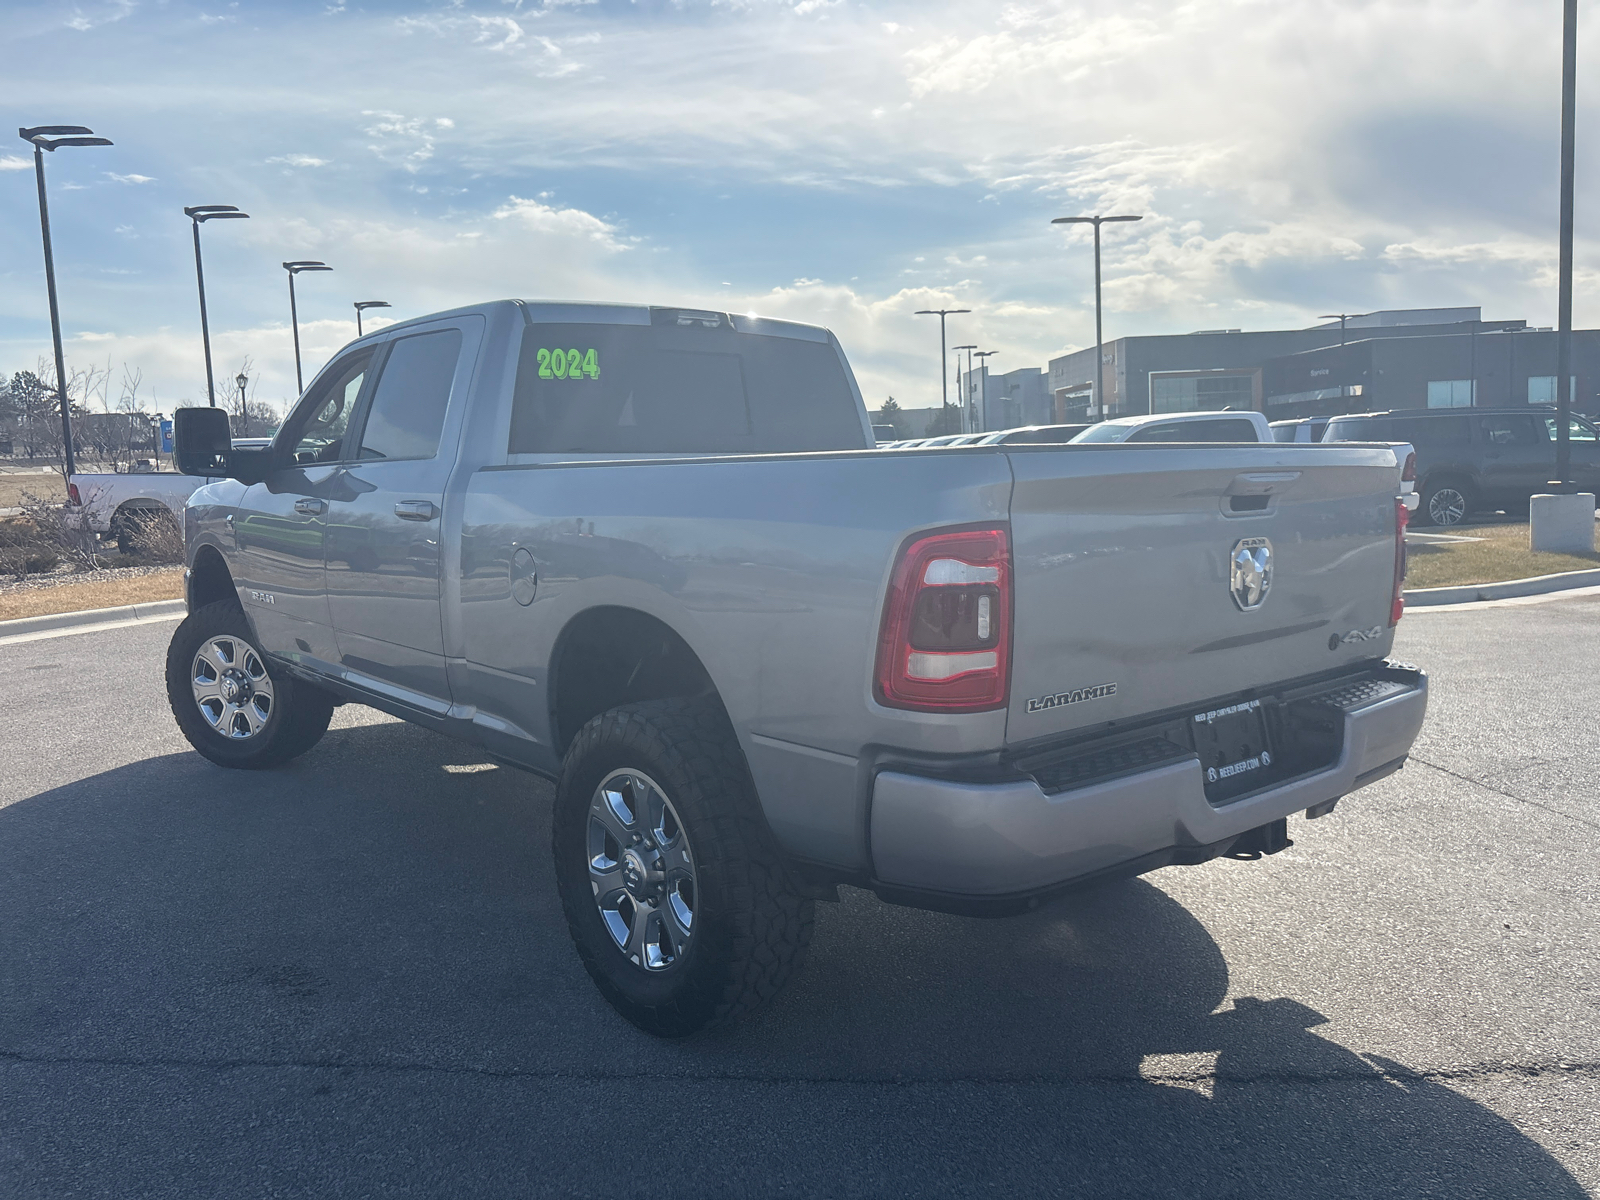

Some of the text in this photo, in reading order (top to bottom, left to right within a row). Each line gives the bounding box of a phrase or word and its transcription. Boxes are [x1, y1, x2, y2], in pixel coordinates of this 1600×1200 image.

[537, 348, 600, 380] 2024
[1242, 539, 1266, 547] RAM
[1027, 682, 1117, 713] LARAMIE
